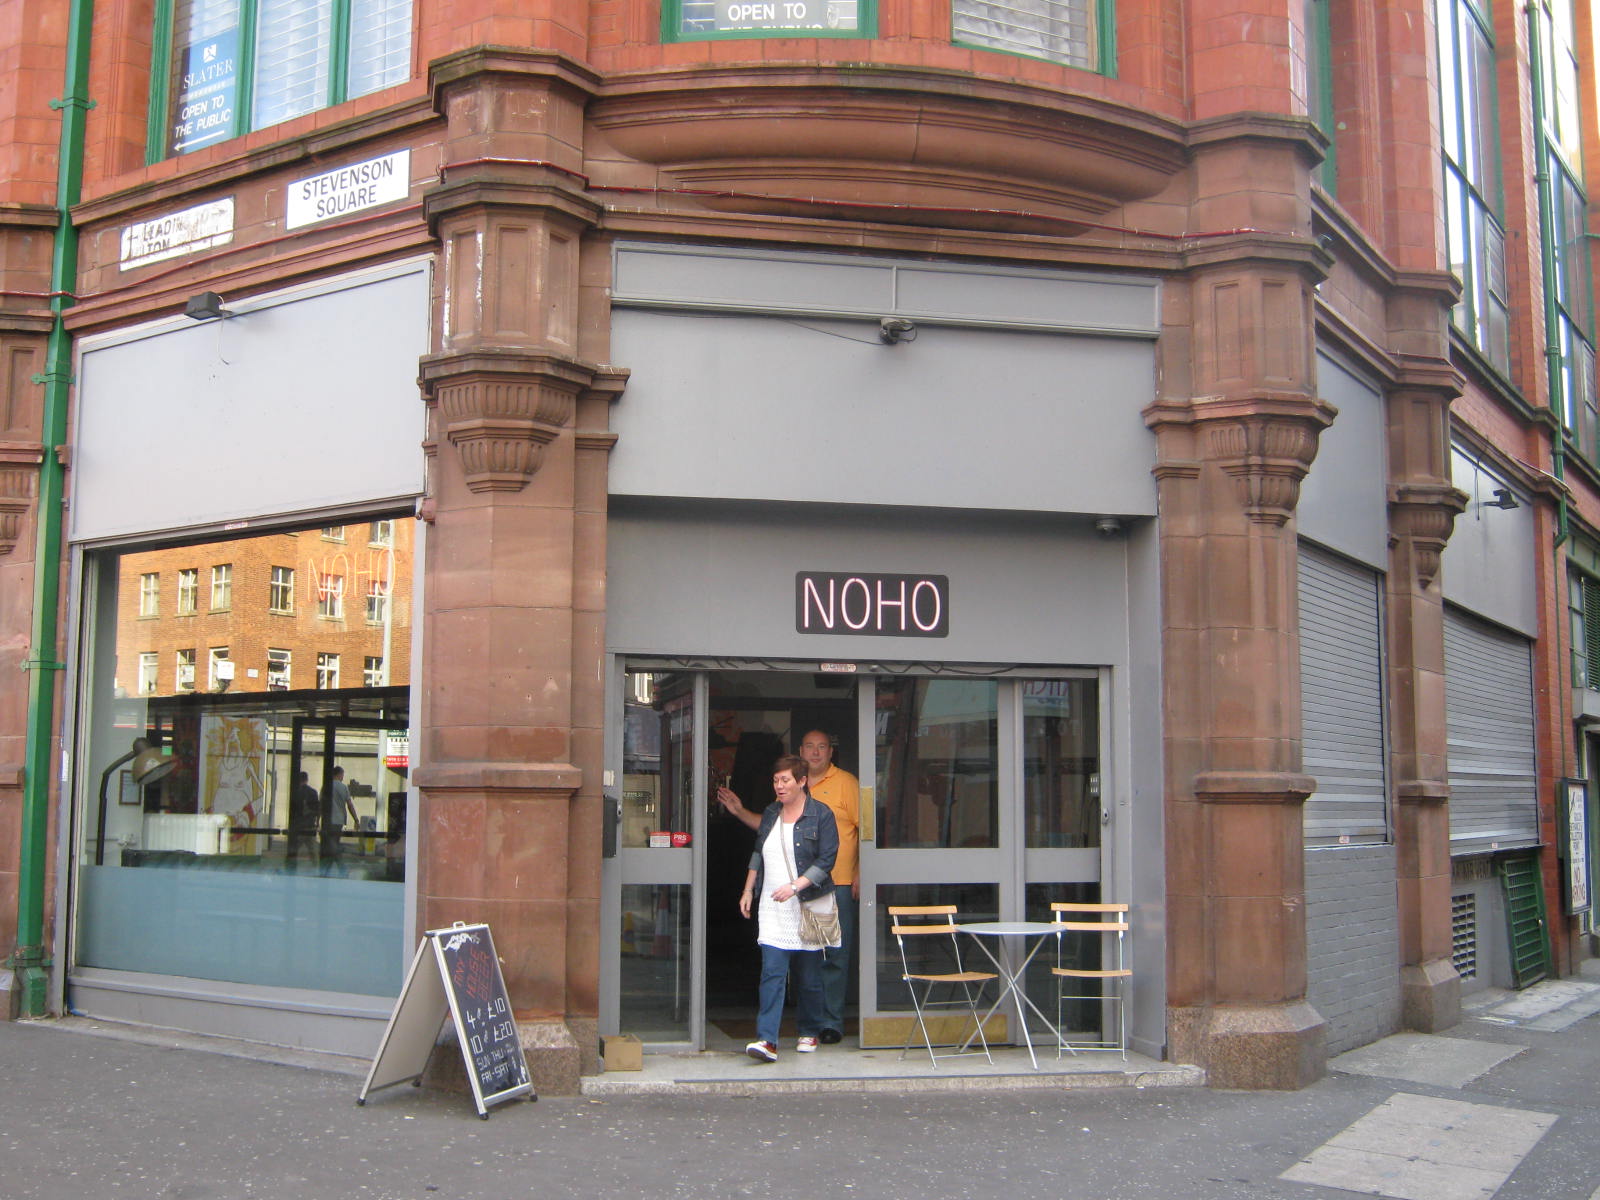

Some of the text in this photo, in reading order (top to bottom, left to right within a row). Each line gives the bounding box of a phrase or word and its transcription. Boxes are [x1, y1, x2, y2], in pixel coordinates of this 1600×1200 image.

[727, 2, 807, 21] OPEN TO
[183, 58, 233, 89] SLATER
[175, 108, 232, 138] THE PUBLIC
[181, 94, 225, 121] OPEN TO
[302, 157, 394, 201] STEVENSON
[316, 184, 378, 218] SQUARE
[142, 213, 190, 243] LEADIN
[307, 549, 397, 602] NOHO
[804, 577, 941, 631] NOHO
[466, 997, 506, 1029] 4 £10
[470, 1021, 513, 1055] 10 £20
